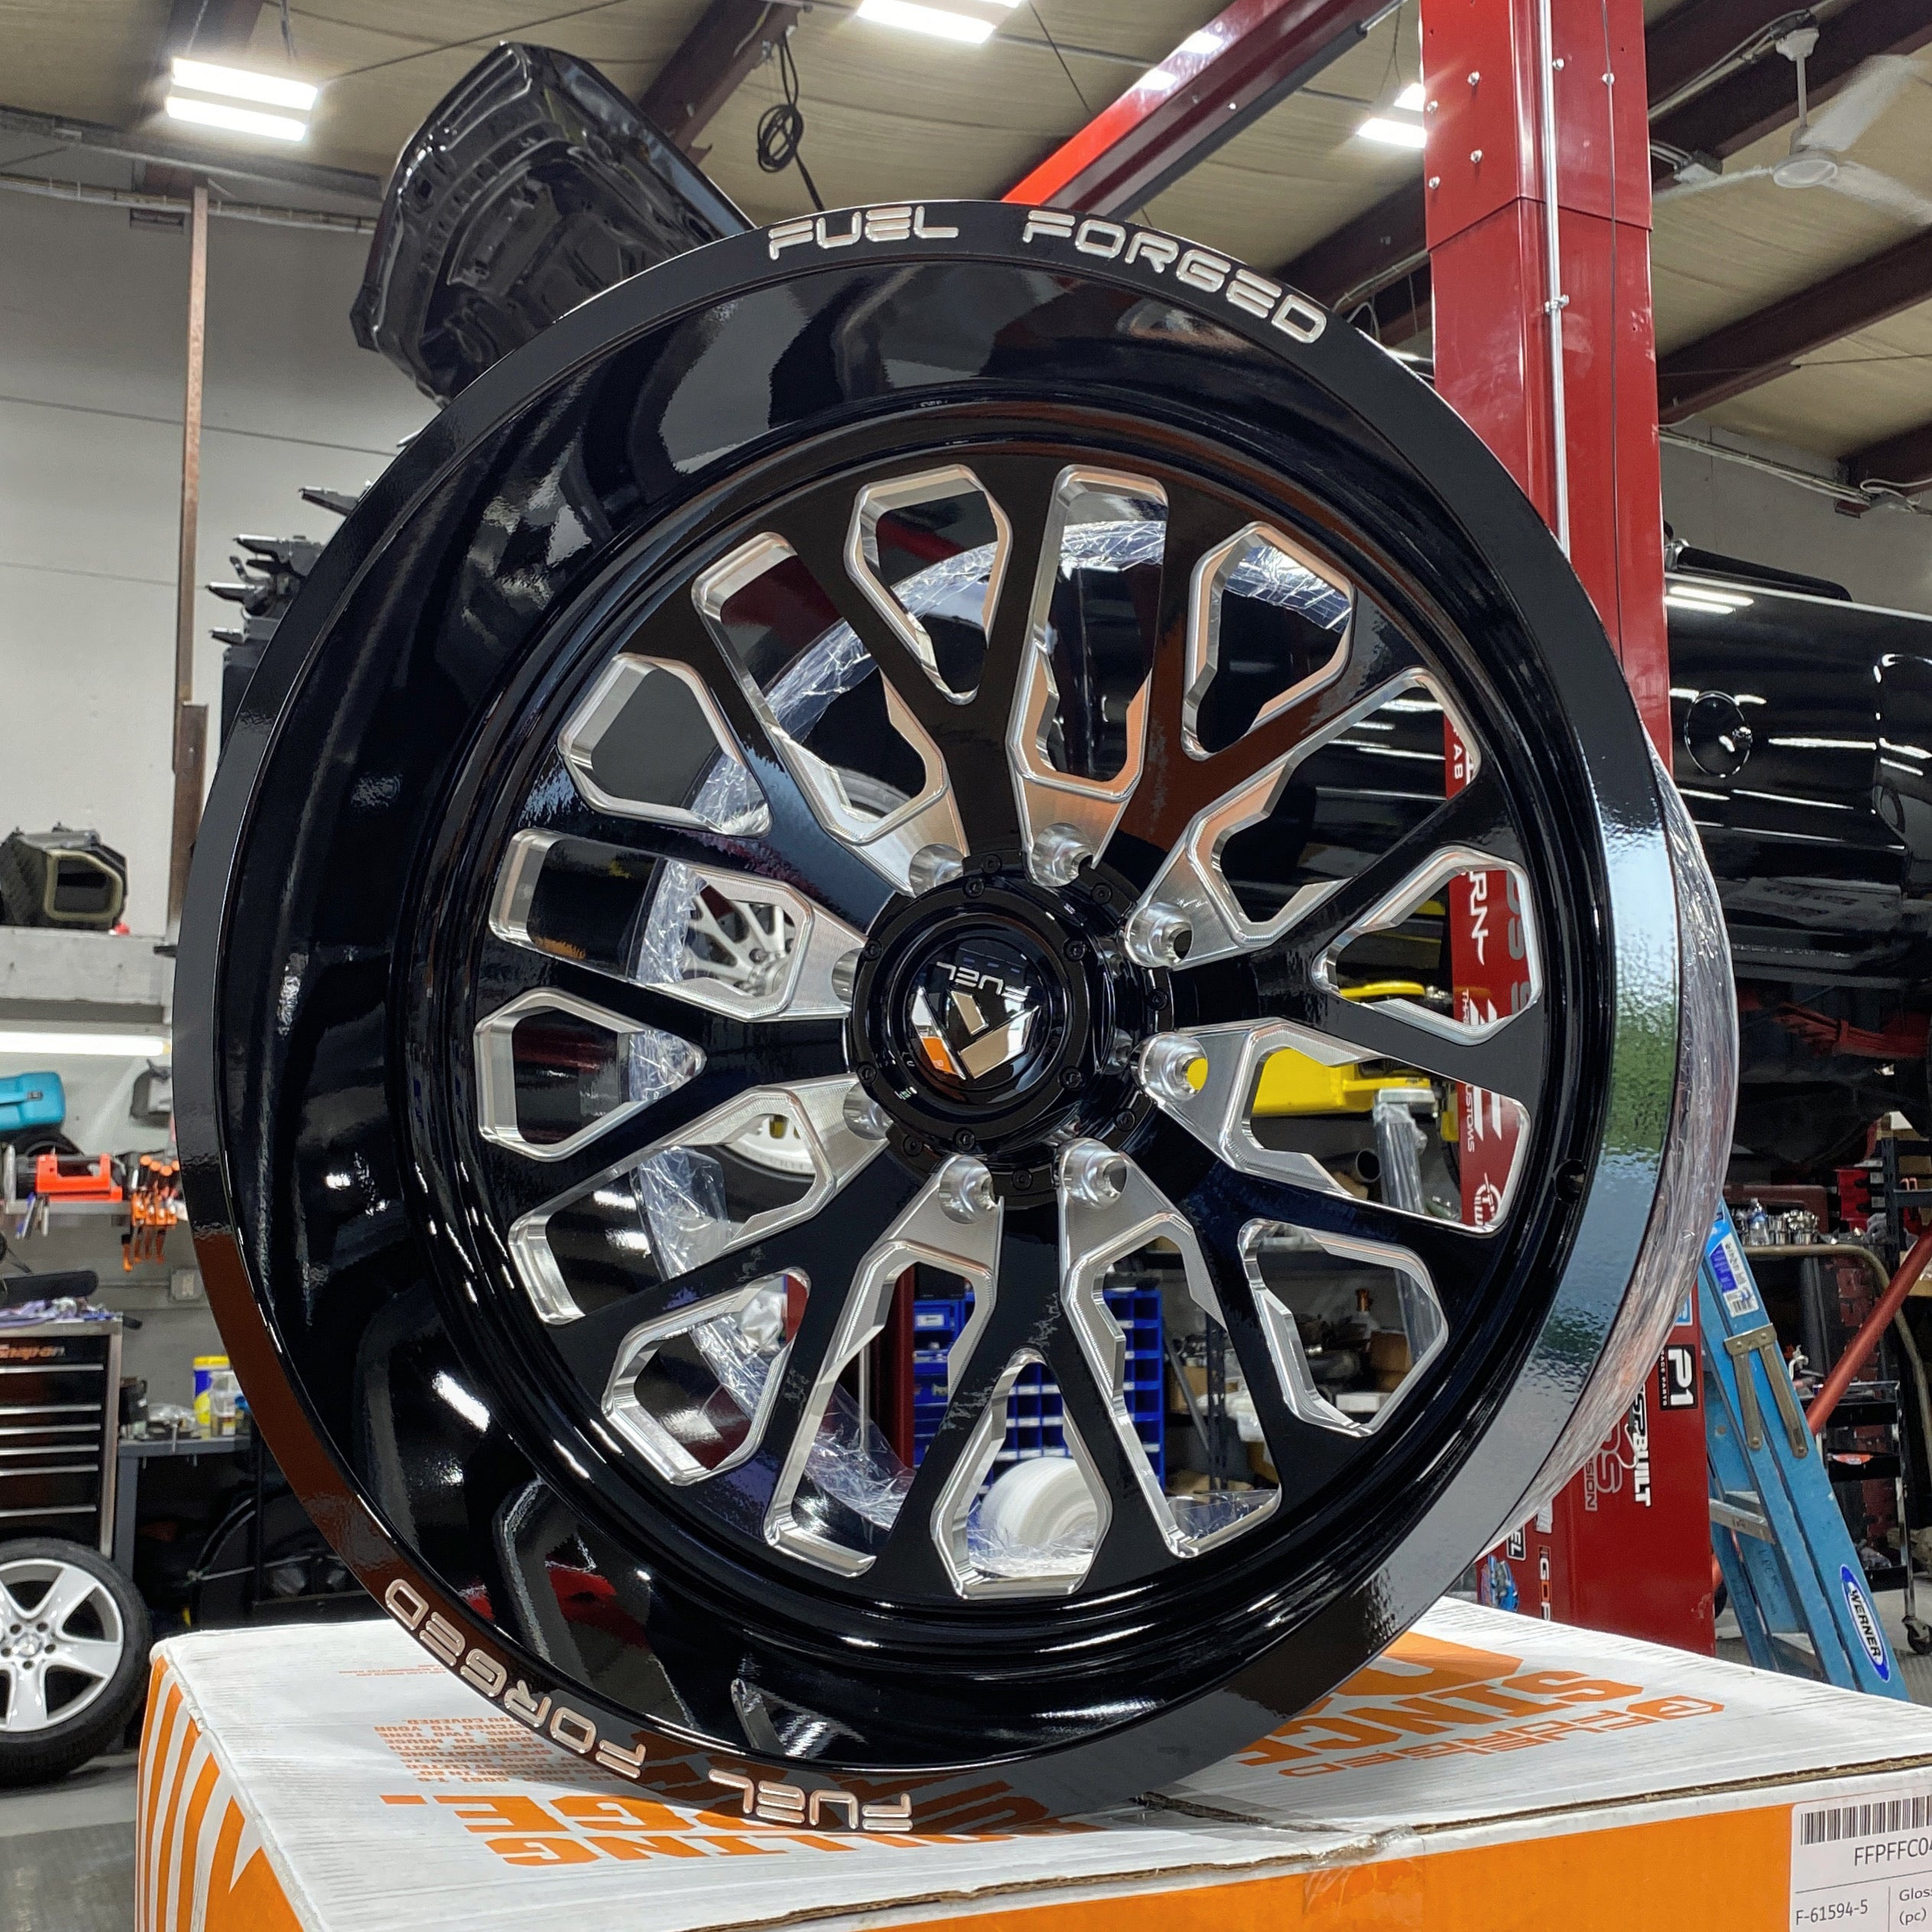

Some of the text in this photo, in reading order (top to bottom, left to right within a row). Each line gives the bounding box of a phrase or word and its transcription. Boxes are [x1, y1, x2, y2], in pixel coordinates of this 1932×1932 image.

[768, 205, 1328, 345] FUEL FORGED
[935, 961, 1032, 1003] FUEL
[1465, 1085, 1475, 1153] USTOMS
[1667, 1348, 1696, 1407] P1
[1510, 1531, 1521, 1556] EL
[1850, 1589, 1882, 1657] WERNER
[384, 1578, 915, 1832] FUEL FORGED
[1795, 1899, 1868, 1926] F-61594-5
[1898, 1907, 1927, 1926] (pc)
